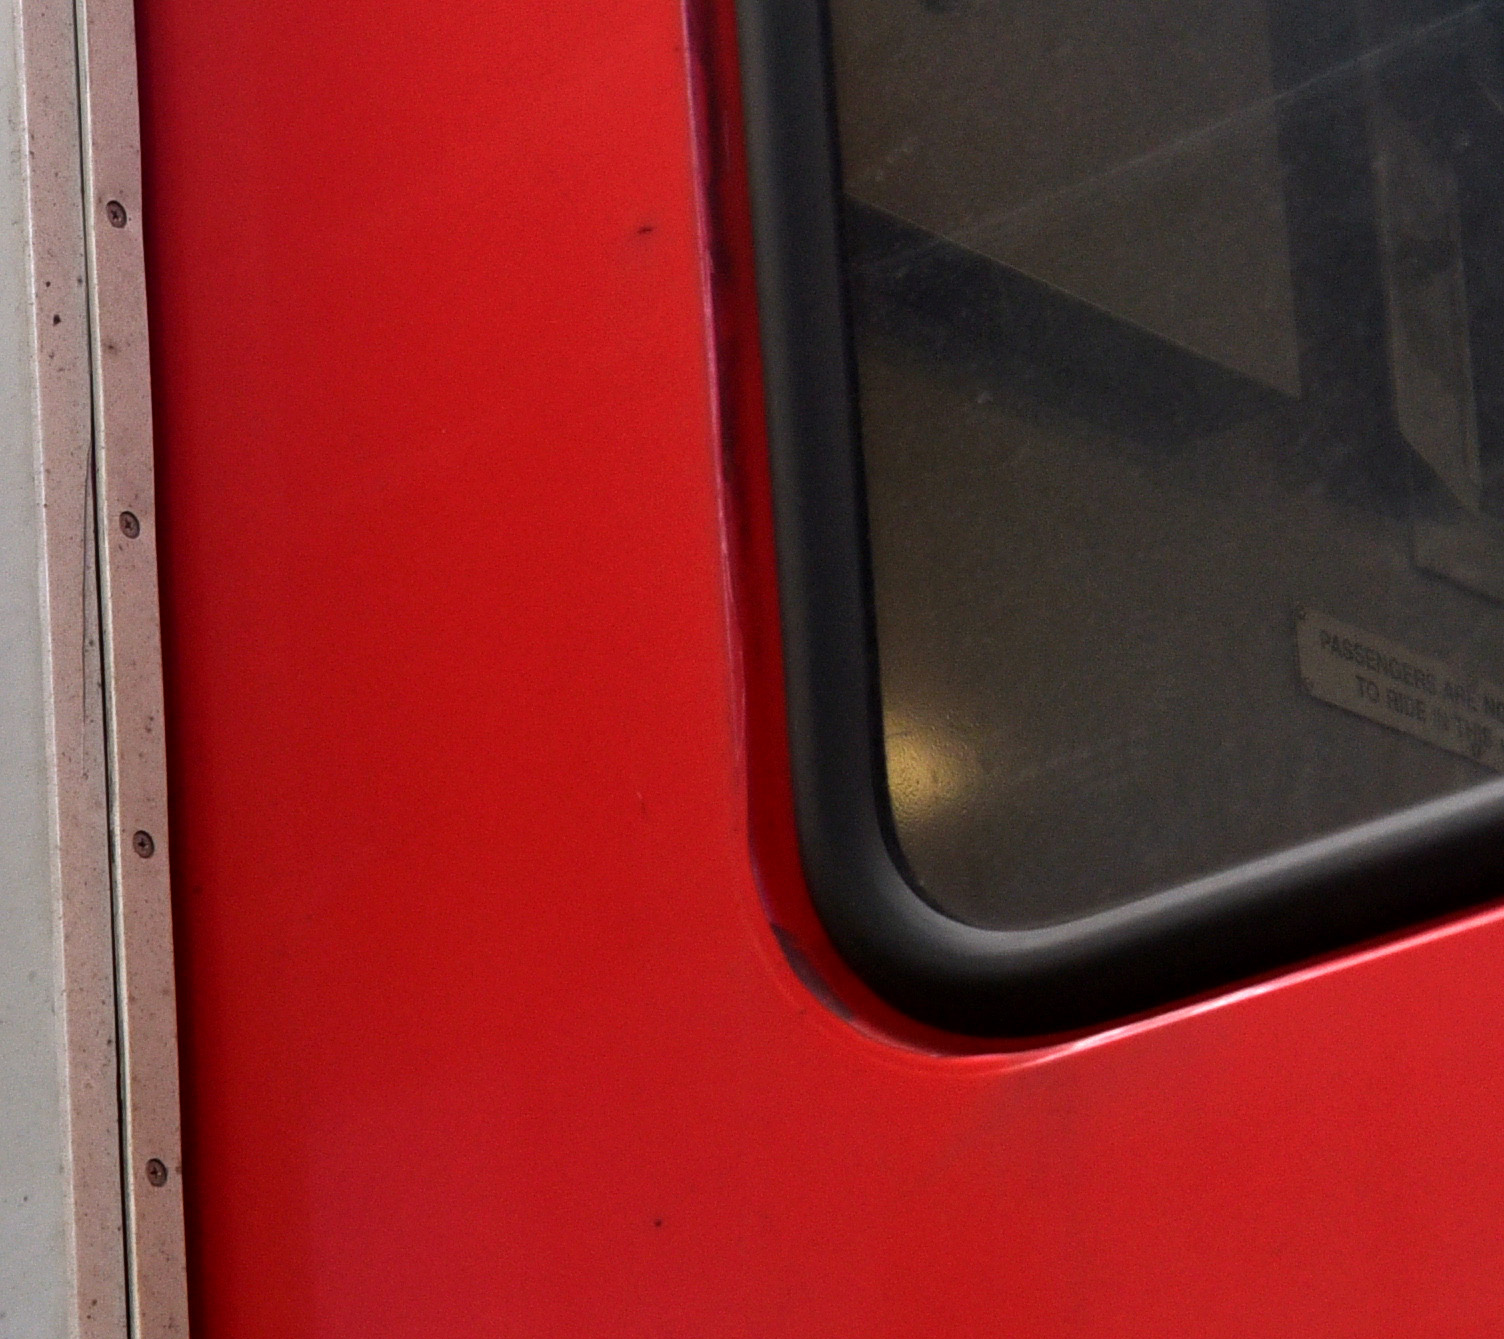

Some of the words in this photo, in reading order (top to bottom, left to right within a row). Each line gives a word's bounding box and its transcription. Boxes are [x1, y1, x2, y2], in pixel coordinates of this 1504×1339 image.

[1320, 630, 1437, 695] PASSENGERS
[1444, 681, 1478, 711] ARE
[1356, 675, 1381, 703] TO
[1386, 689, 1427, 722] RIDE
